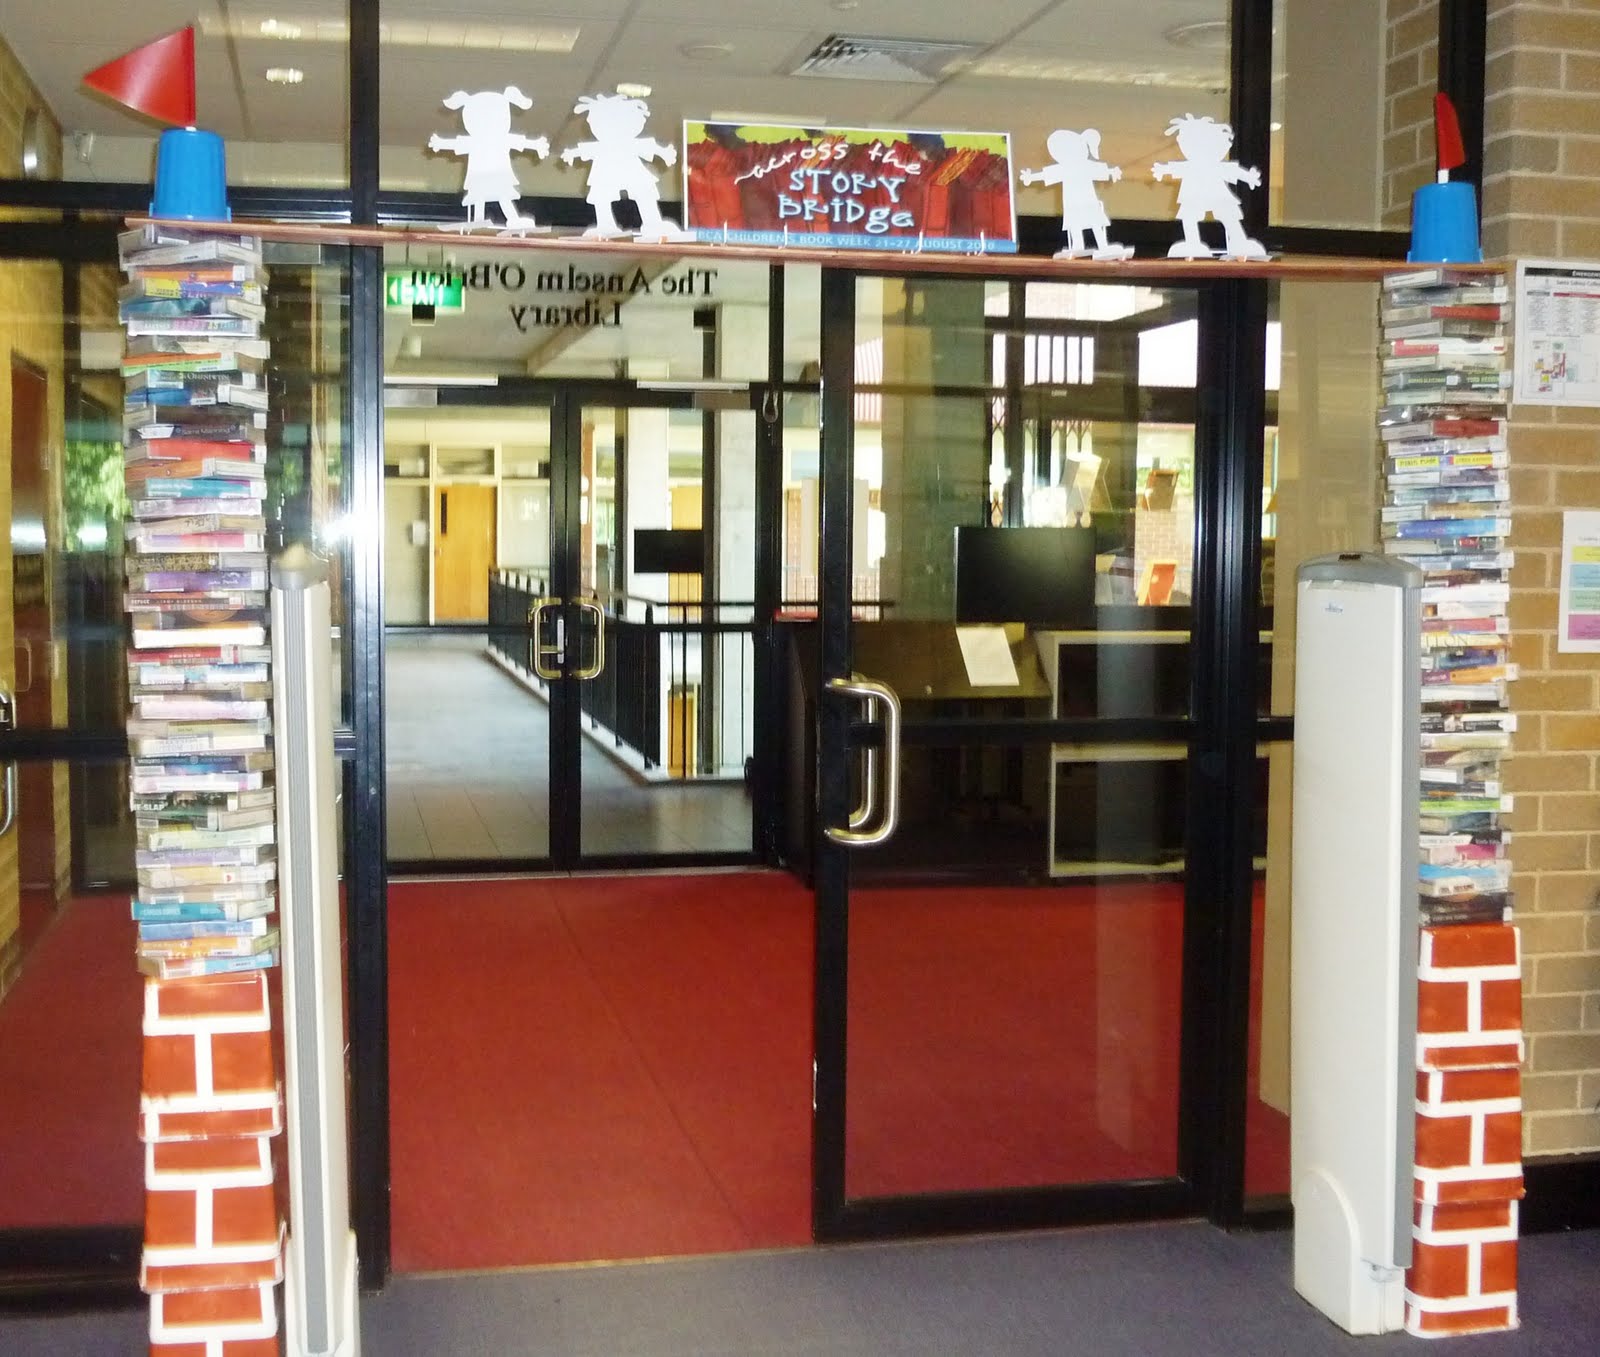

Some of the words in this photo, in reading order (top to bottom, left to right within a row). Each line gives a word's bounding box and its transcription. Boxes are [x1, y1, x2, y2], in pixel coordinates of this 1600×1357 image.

[734, 143, 849, 185] across
[869, 142, 921, 175] the
[788, 167, 907, 203] STORY
[727, 231, 796, 244] CHILDRENS
[799, 234, 833, 246] BOOK
[836, 236, 870, 247] WEEK
[914, 239, 962, 250] AUGUST
